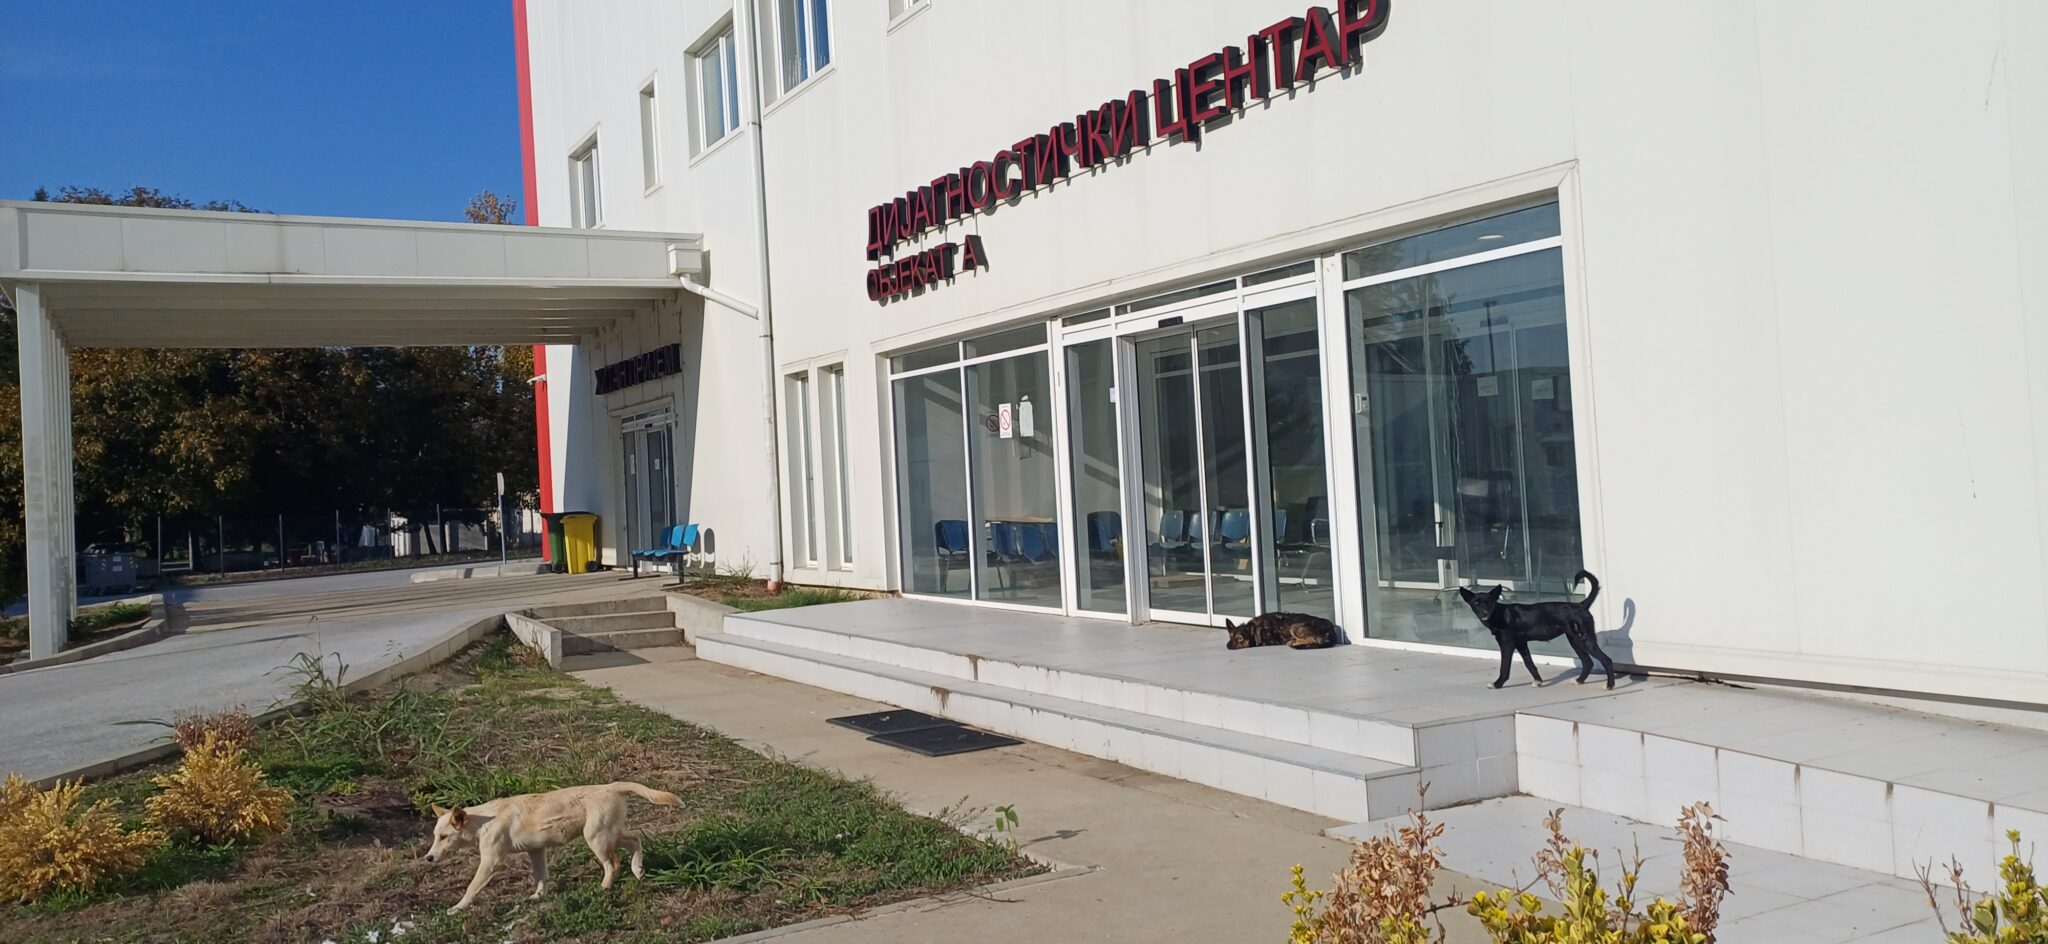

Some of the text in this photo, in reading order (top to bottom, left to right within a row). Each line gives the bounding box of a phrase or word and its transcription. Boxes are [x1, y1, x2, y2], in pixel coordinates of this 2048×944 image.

[866, 0, 1386, 261] ДИЈАГНОСТИЧКИ ЦЕНТАР
[866, 235, 984, 302] ОБЈЕКАТ А
